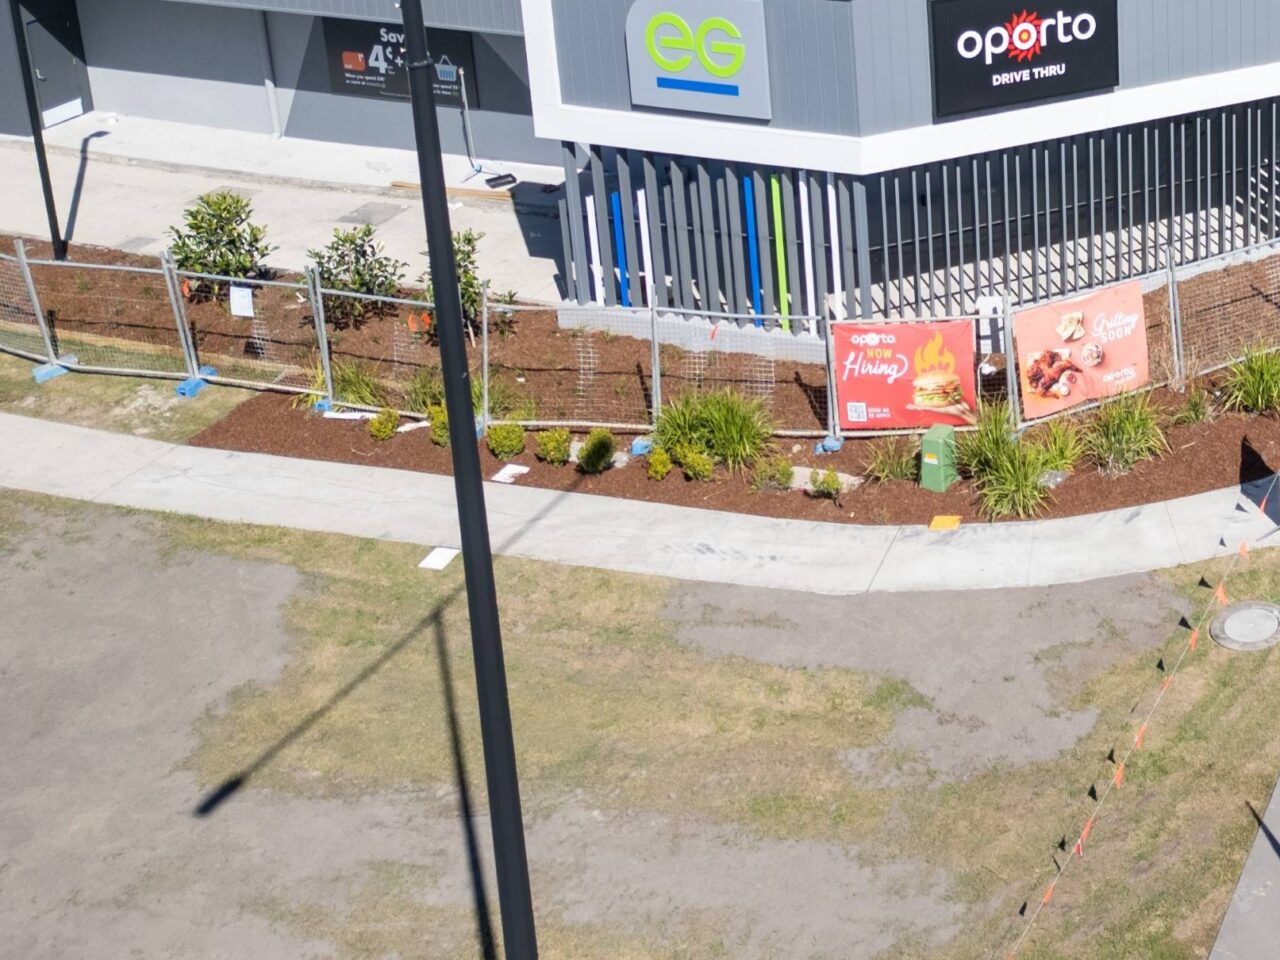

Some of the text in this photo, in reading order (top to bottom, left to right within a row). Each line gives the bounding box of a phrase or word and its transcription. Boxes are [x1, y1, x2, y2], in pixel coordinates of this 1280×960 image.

[379, 27, 405, 43] Sav
[956, 9, 1097, 65] oporto
[991, 63, 1066, 87] DRIVE THRU
[866, 348, 892, 359] NOW
[843, 351, 909, 384] Hiring
